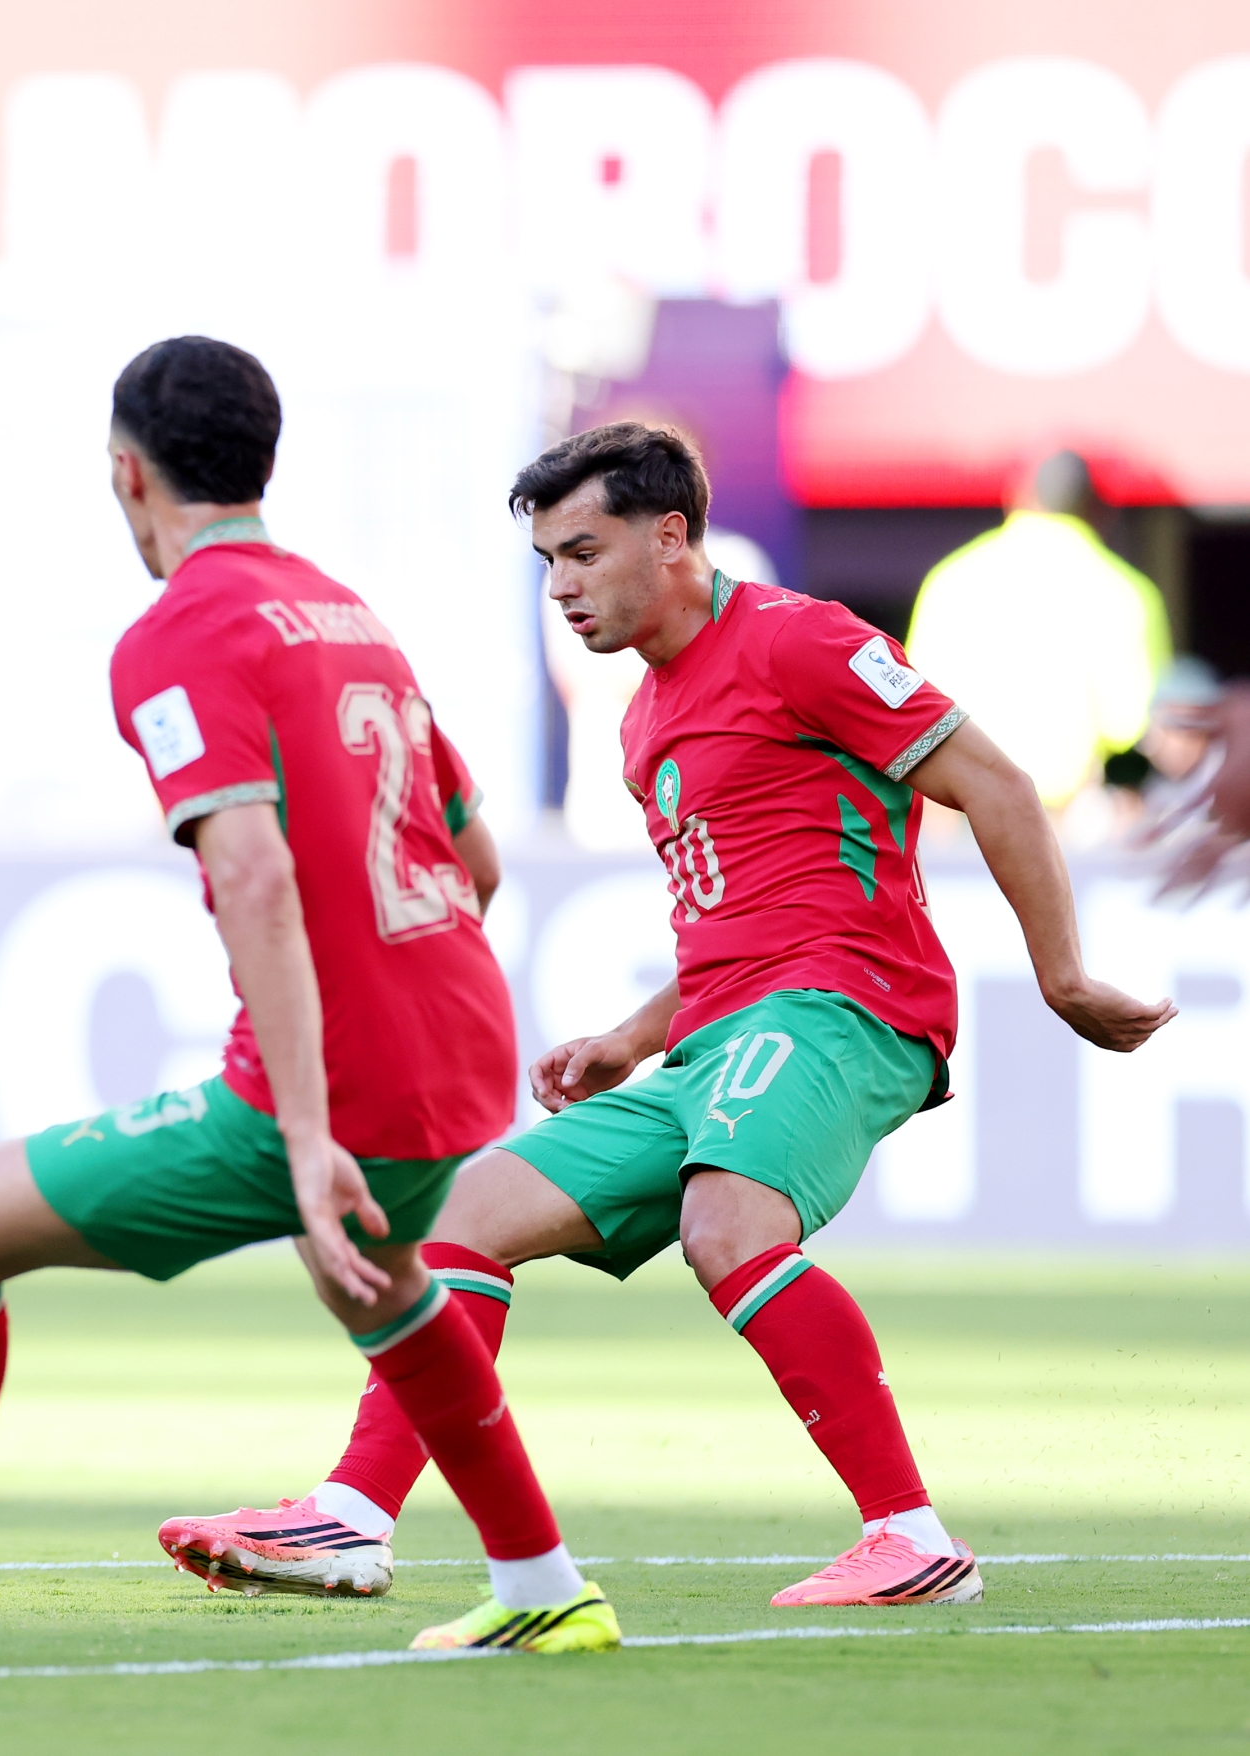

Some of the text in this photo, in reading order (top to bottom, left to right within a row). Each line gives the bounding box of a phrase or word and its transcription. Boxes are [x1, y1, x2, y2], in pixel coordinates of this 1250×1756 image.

[889, 669, 908, 688] PEACE
[664, 813, 726, 923] 10
[708, 1032, 795, 1112] 10
